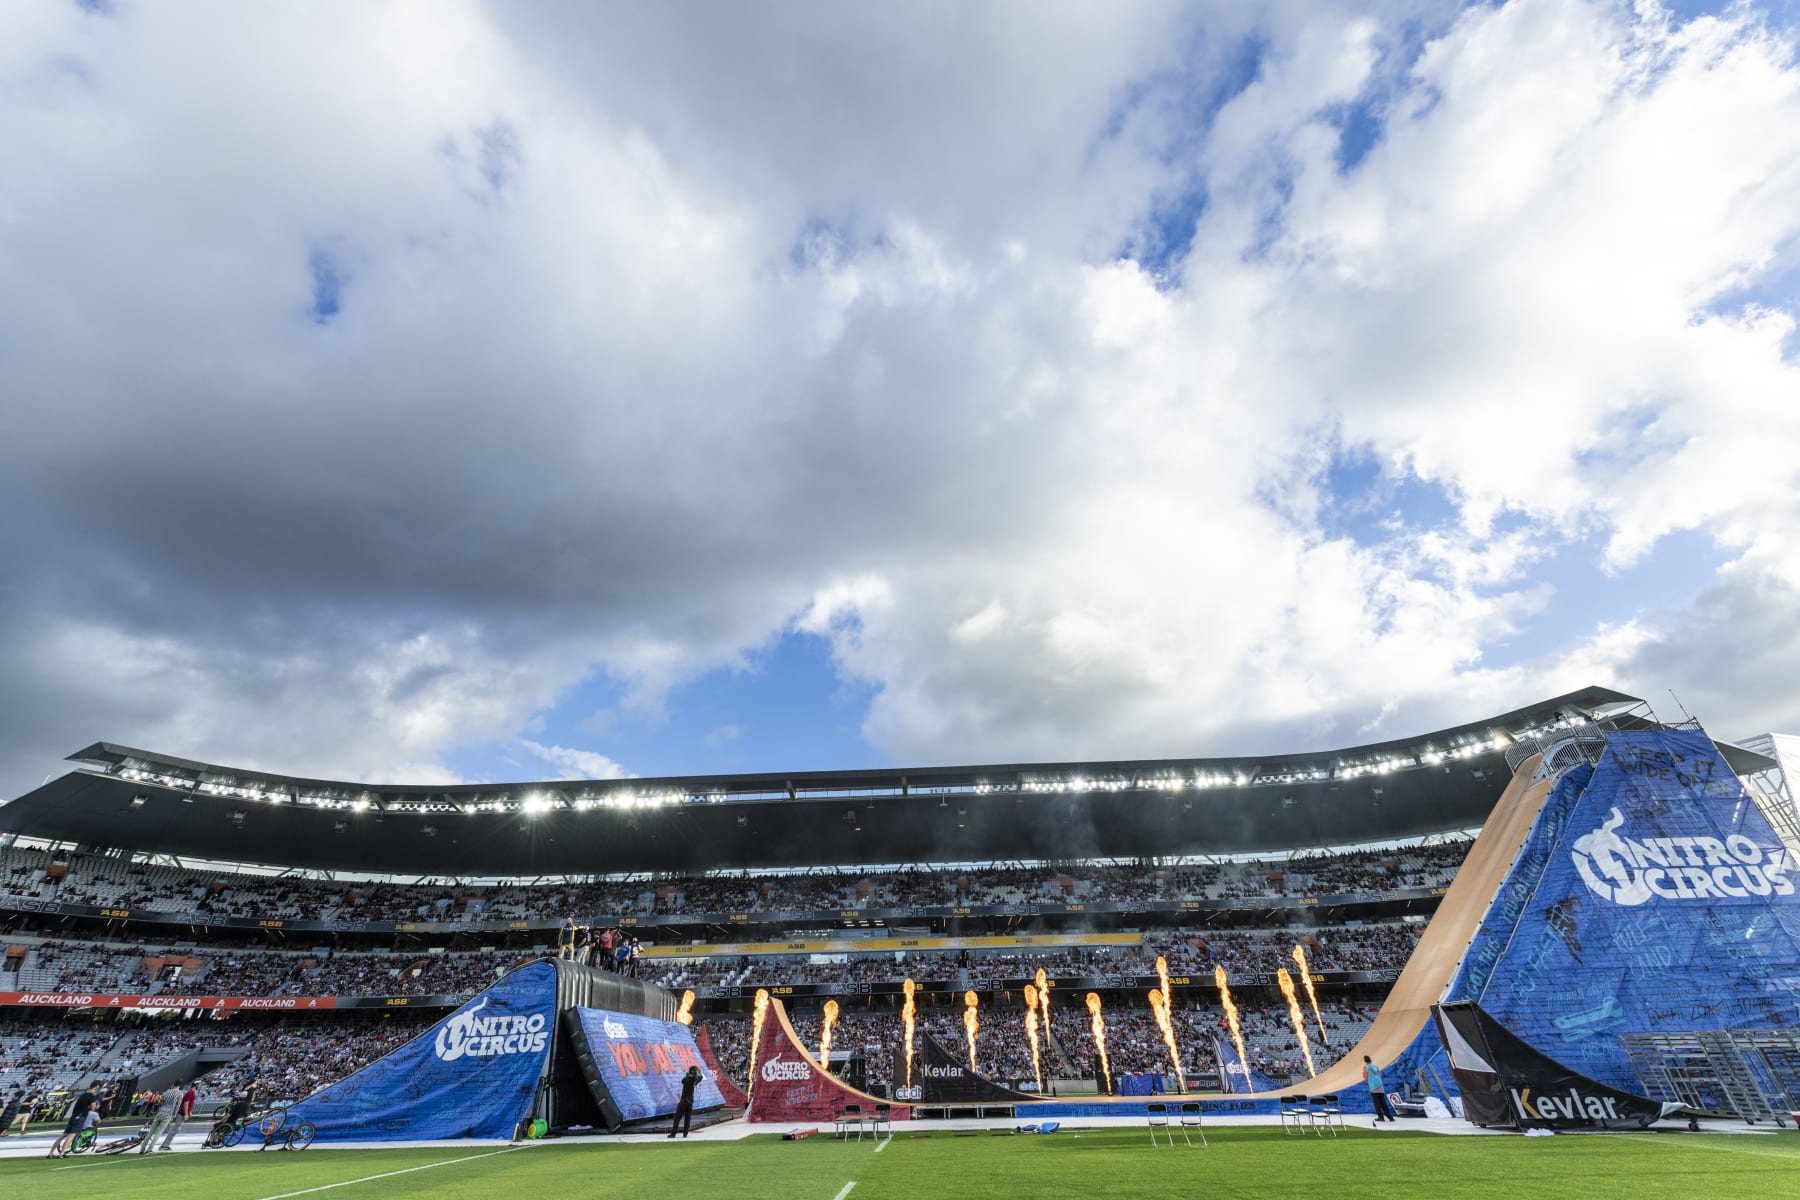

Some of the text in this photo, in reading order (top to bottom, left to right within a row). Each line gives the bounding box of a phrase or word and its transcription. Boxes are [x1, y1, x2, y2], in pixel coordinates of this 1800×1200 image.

[1624, 834, 1763, 868] NITRO
[1644, 850, 1795, 899] CIRCUS
[100, 908, 130, 917] ASB
[258, 920, 284, 928] ASB
[18, 994, 92, 1005] AUCKLAND
[137, 997, 201, 1007] AUCKLAND
[240, 999, 296, 1007] AUCKLAND
[386, 998, 408, 1006] ASB
[471, 1013, 545, 1036] NITRO
[465, 1032, 549, 1056] CIRCUS
[606, 1040, 649, 1078] YOU
[776, 1061, 809, 1071] NITRO
[776, 1070, 811, 1080] CIRCUS
